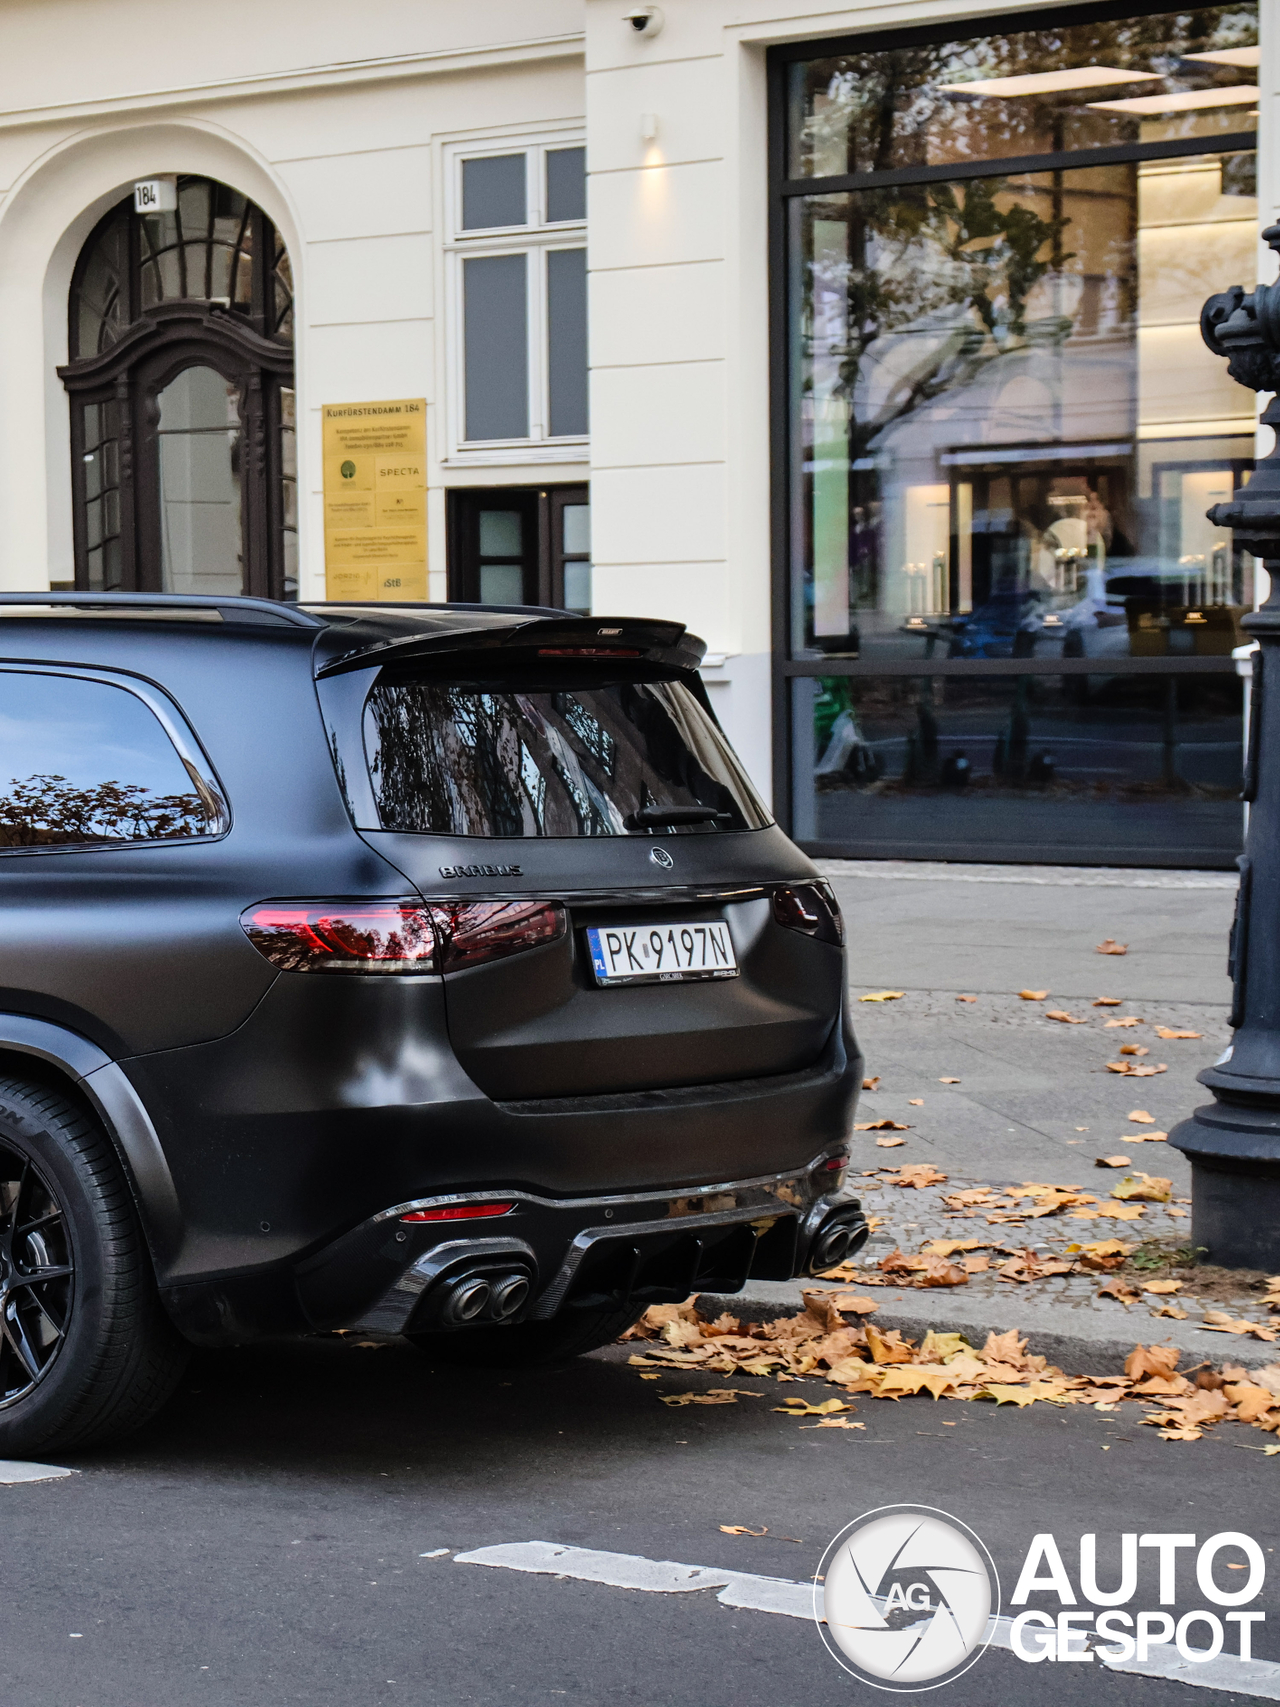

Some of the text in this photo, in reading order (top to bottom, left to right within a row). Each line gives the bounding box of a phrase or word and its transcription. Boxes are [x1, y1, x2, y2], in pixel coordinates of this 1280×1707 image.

[136, 185, 156, 206] 184
[404, 403, 420, 412] 184
[380, 467, 420, 476] SPECTA
[438, 864, 524, 879] BRABUS
[606, 927, 729, 972] PK 9197N
[594, 959, 606, 970] PL
